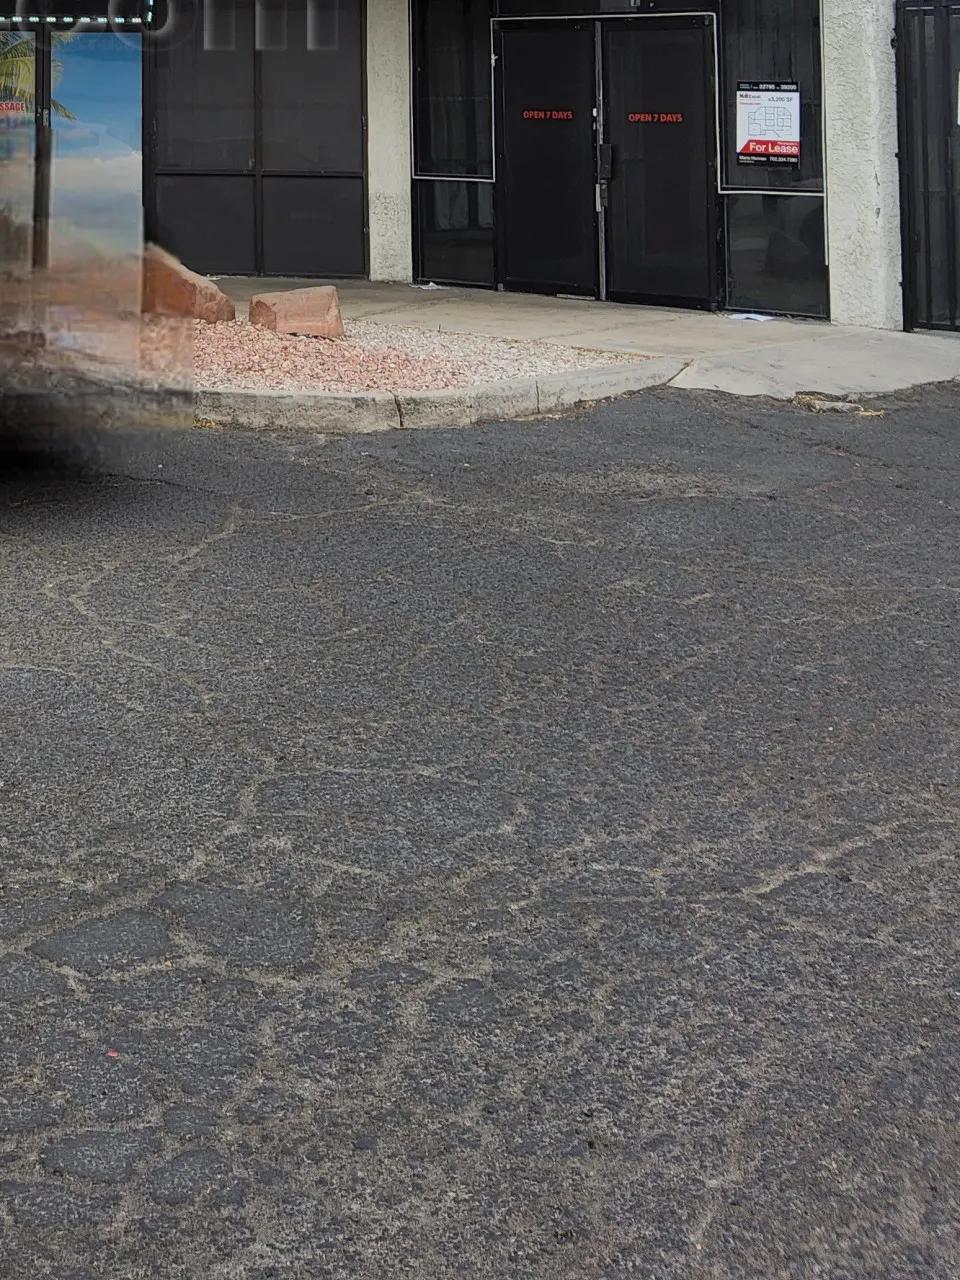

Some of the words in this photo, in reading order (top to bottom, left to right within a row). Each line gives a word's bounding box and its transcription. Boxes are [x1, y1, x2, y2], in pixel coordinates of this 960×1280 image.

[523, 110, 544, 119] OPEN
[552, 111, 573, 119] DAYS
[628, 113, 652, 122] OPEN
[660, 113, 683, 122] DAYS
[749, 142, 767, 152] For
[768, 143, 799, 154] Lease
